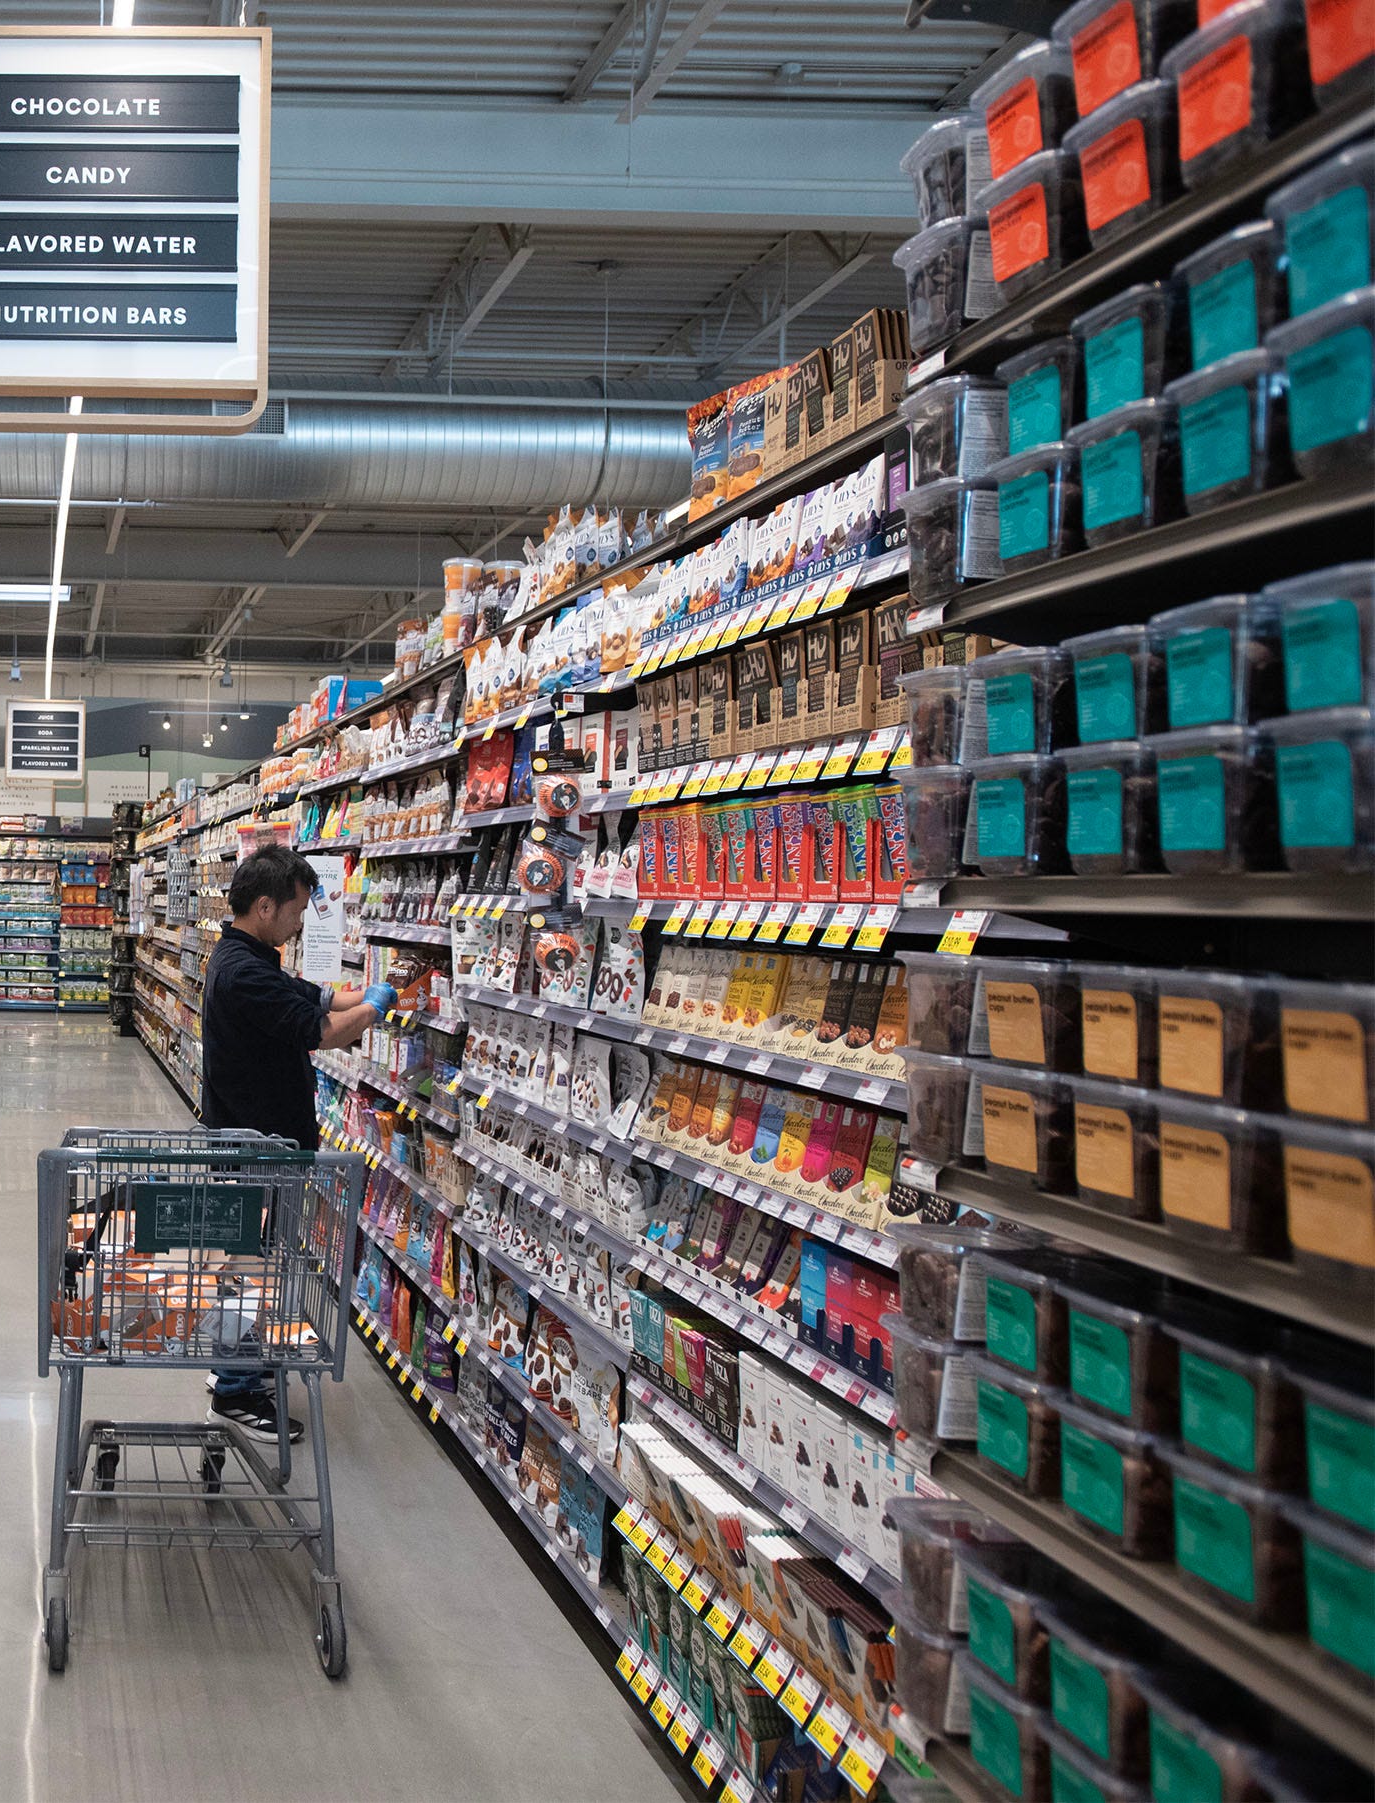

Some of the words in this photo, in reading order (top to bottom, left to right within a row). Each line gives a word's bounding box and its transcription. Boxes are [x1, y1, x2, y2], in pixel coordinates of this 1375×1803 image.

[11, 98, 160, 116] CHOCOLATE
[46, 167, 131, 184] CANDY
[113, 236, 196, 254] WATER
[127, 307, 187, 325] BARS
[988, 993, 1012, 1005] peanut
[1013, 994, 1035, 1004] butter
[988, 1003, 1005, 1014] cups
[1085, 1001, 1109, 1014] peanut
[1109, 1003, 1132, 1015] butter
[1085, 1013, 1101, 1024] cups
[984, 1097, 1007, 1109] peanut
[1008, 1101, 1029, 1112] butter
[985, 1107, 1001, 1118] cups
[713, 1361, 729, 1381] TAZA
